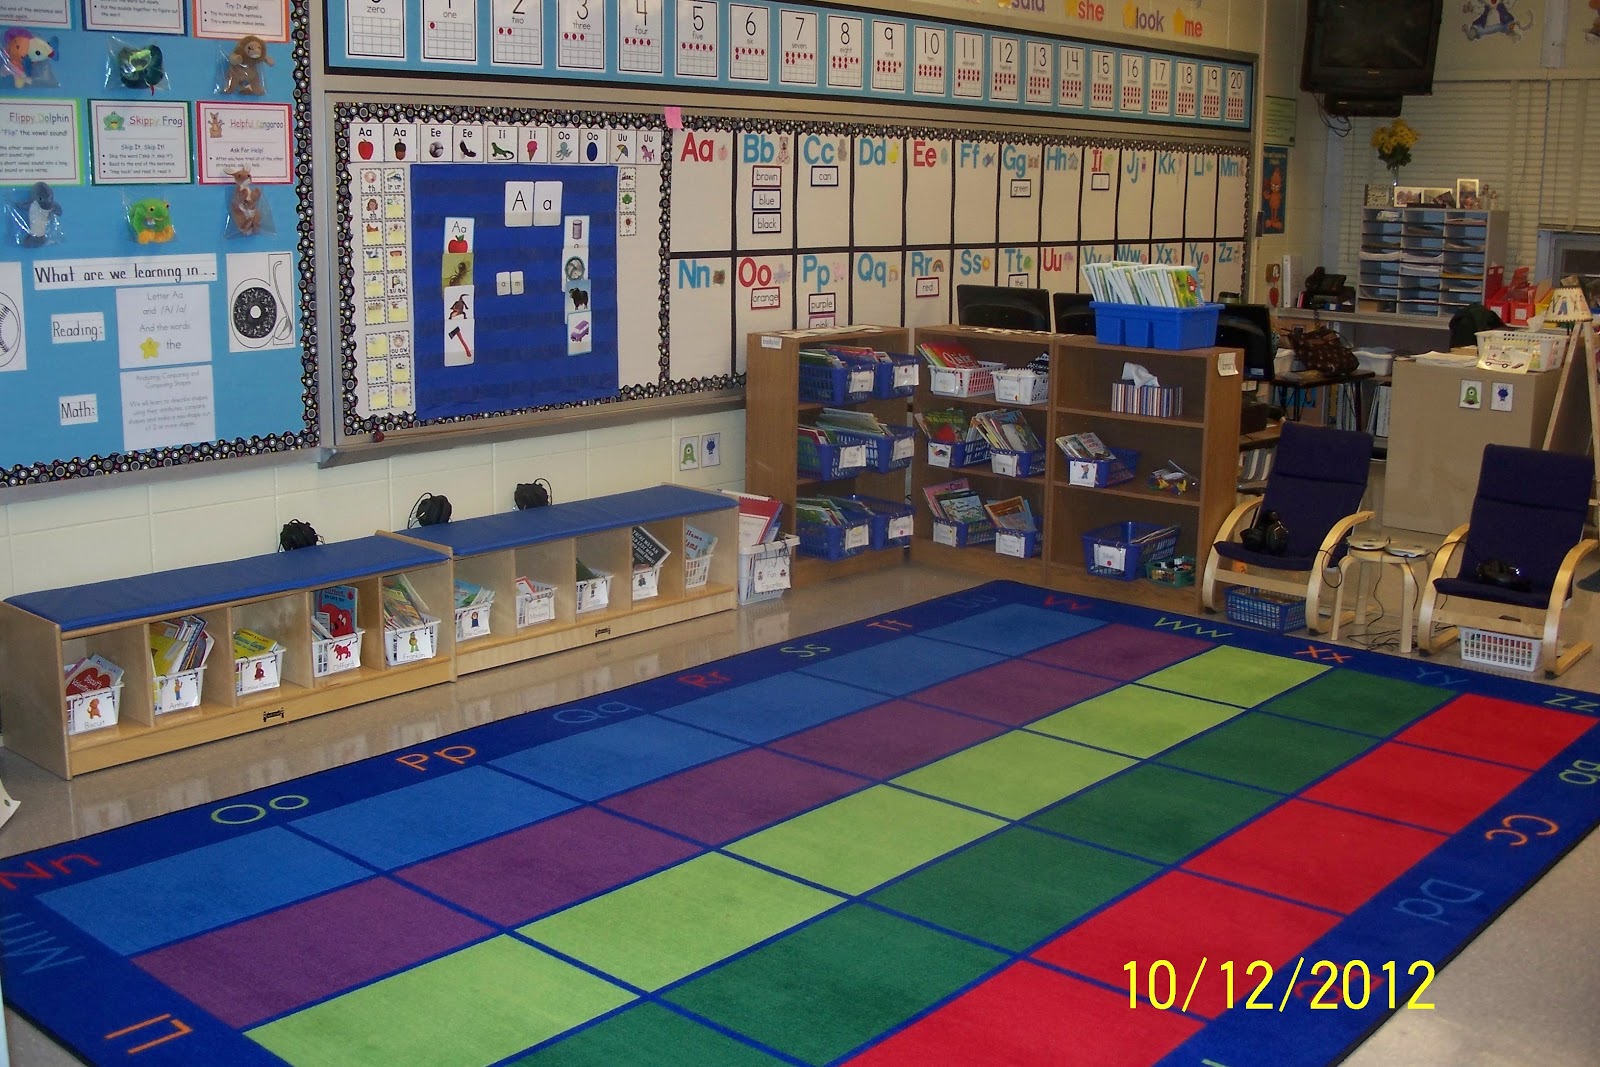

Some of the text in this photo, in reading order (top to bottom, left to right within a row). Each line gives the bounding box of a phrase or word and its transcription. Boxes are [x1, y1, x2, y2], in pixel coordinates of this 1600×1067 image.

[366, 6, 386, 14] zero
[512, 16, 524, 24] two
[577, 0, 588, 20] 3
[636, 0, 647, 26] 4
[693, 6, 704, 31] 5
[1078, 2, 1104, 22] she
[1136, 7, 1164, 32] look
[1185, 18, 1202, 36] me
[573, 21, 591, 30] three
[634, 26, 648, 35] four
[746, 12, 756, 35] 6
[795, 17, 805, 40] 7
[841, 22, 850, 45] 8
[692, 32, 704, 40] five
[885, 27, 894, 49] 9
[923, 32, 940, 54] 10
[963, 38, 974, 59] 11
[999, 42, 1013, 63] 12
[1034, 46, 1047, 66] 13
[1066, 50, 1078, 70] 14
[1098, 55, 1109, 74] 15
[1127, 58, 1138, 78] 16
[1155, 63, 1166, 81] 17
[1182, 66, 1192, 84] 18
[1208, 69, 1217, 86] 19
[1230, 72, 1242, 89] 20
[10, 112, 69, 124] Flippy Dolphin
[129, 116, 183, 127] Skippy Frog
[358, 128, 372, 137] Aa
[393, 128, 406, 137] Aa
[431, 128, 441, 137] Ee
[462, 129, 473, 138] Ee
[499, 130, 506, 139] Ii
[529, 131, 536, 139] Ii
[558, 132, 570, 140] Oo
[587, 132, 598, 141] Oo
[618, 133, 628, 142] Uu
[644, 134, 653, 143] Uu
[680, 132, 714, 162] Aa
[743, 134, 774, 164] Bb
[803, 135, 835, 164] Cc
[859, 138, 886, 165] Dd
[913, 141, 937, 167] Ee
[960, 143, 980, 169] Ff
[1003, 146, 1027, 178] Gg
[1046, 147, 1067, 171] Hh
[1091, 150, 1103, 172] Ii
[1126, 152, 1139, 183] Jj
[1158, 154, 1175, 175] Kk
[1193, 155, 1205, 176] Ll
[1220, 156, 1239, 177] Mm
[756, 170, 778, 182] brown
[819, 172, 832, 181] can
[1014, 184, 1029, 195] green
[512, 191, 552, 211] A a
[759, 195, 775, 206] blue
[452, 221, 467, 234] Aa
[757, 219, 777, 229] black
[1004, 249, 1022, 273] Tt
[1043, 248, 1062, 272] Uu
[1117, 244, 1141, 262] Ww
[1156, 243, 1172, 264] Xx
[1190, 243, 1205, 271] Yy
[1219, 242, 1232, 262] Zz
[738, 257, 772, 288] Oo
[858, 254, 886, 288] Qq
[911, 252, 932, 277] Rr
[960, 249, 981, 276] Ss
[34, 266, 75, 283] What
[84, 270, 104, 281] are
[110, 270, 127, 280] we
[134, 264, 181, 283] learning
[678, 260, 710, 289] Nn
[803, 255, 830, 292] Pp
[147, 290, 183, 301] Letter Aa
[922, 282, 933, 292] red
[753, 293, 779, 306] orange
[811, 299, 833, 312] purple
[143, 307, 156, 315] and
[53, 321, 103, 341] Reading:
[140, 324, 155, 332] And
[157, 323, 168, 331] the
[166, 339, 181, 349] the
[61, 402, 95, 419] Math:
[780, 643, 831, 658] Ss
[333, 662, 354, 671] Clifford
[552, 701, 643, 725] Qq
[396, 745, 476, 772] Pp
[211, 795, 309, 825] Oo
[1485, 814, 1559, 847] Cc
[0, 854, 100, 890] Nn
